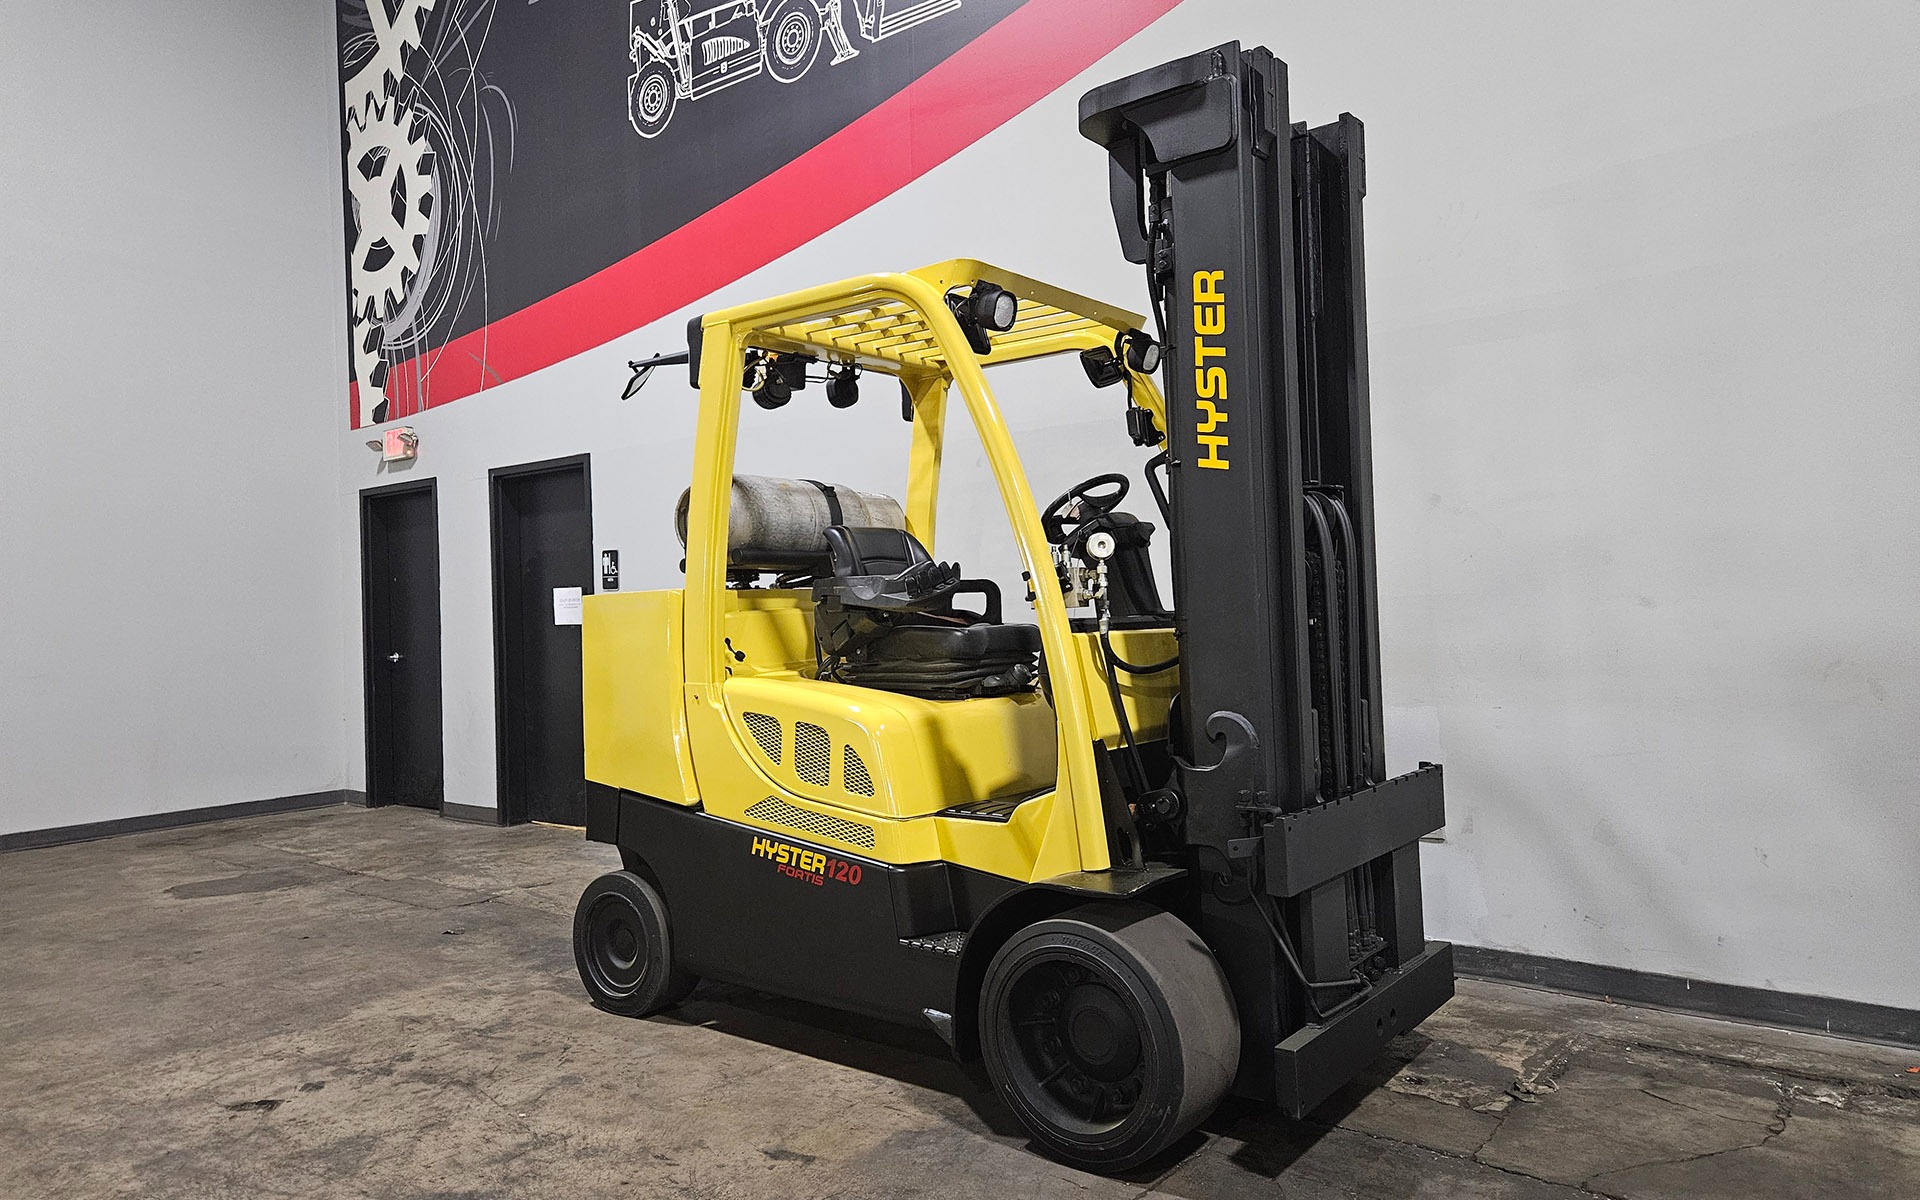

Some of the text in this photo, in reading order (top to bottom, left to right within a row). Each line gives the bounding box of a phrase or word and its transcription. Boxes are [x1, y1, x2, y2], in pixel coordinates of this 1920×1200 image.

[1193, 269, 1230, 470] HYSTER
[751, 836, 863, 886] HYSTER 120
[777, 863, 825, 887] FORTIS
